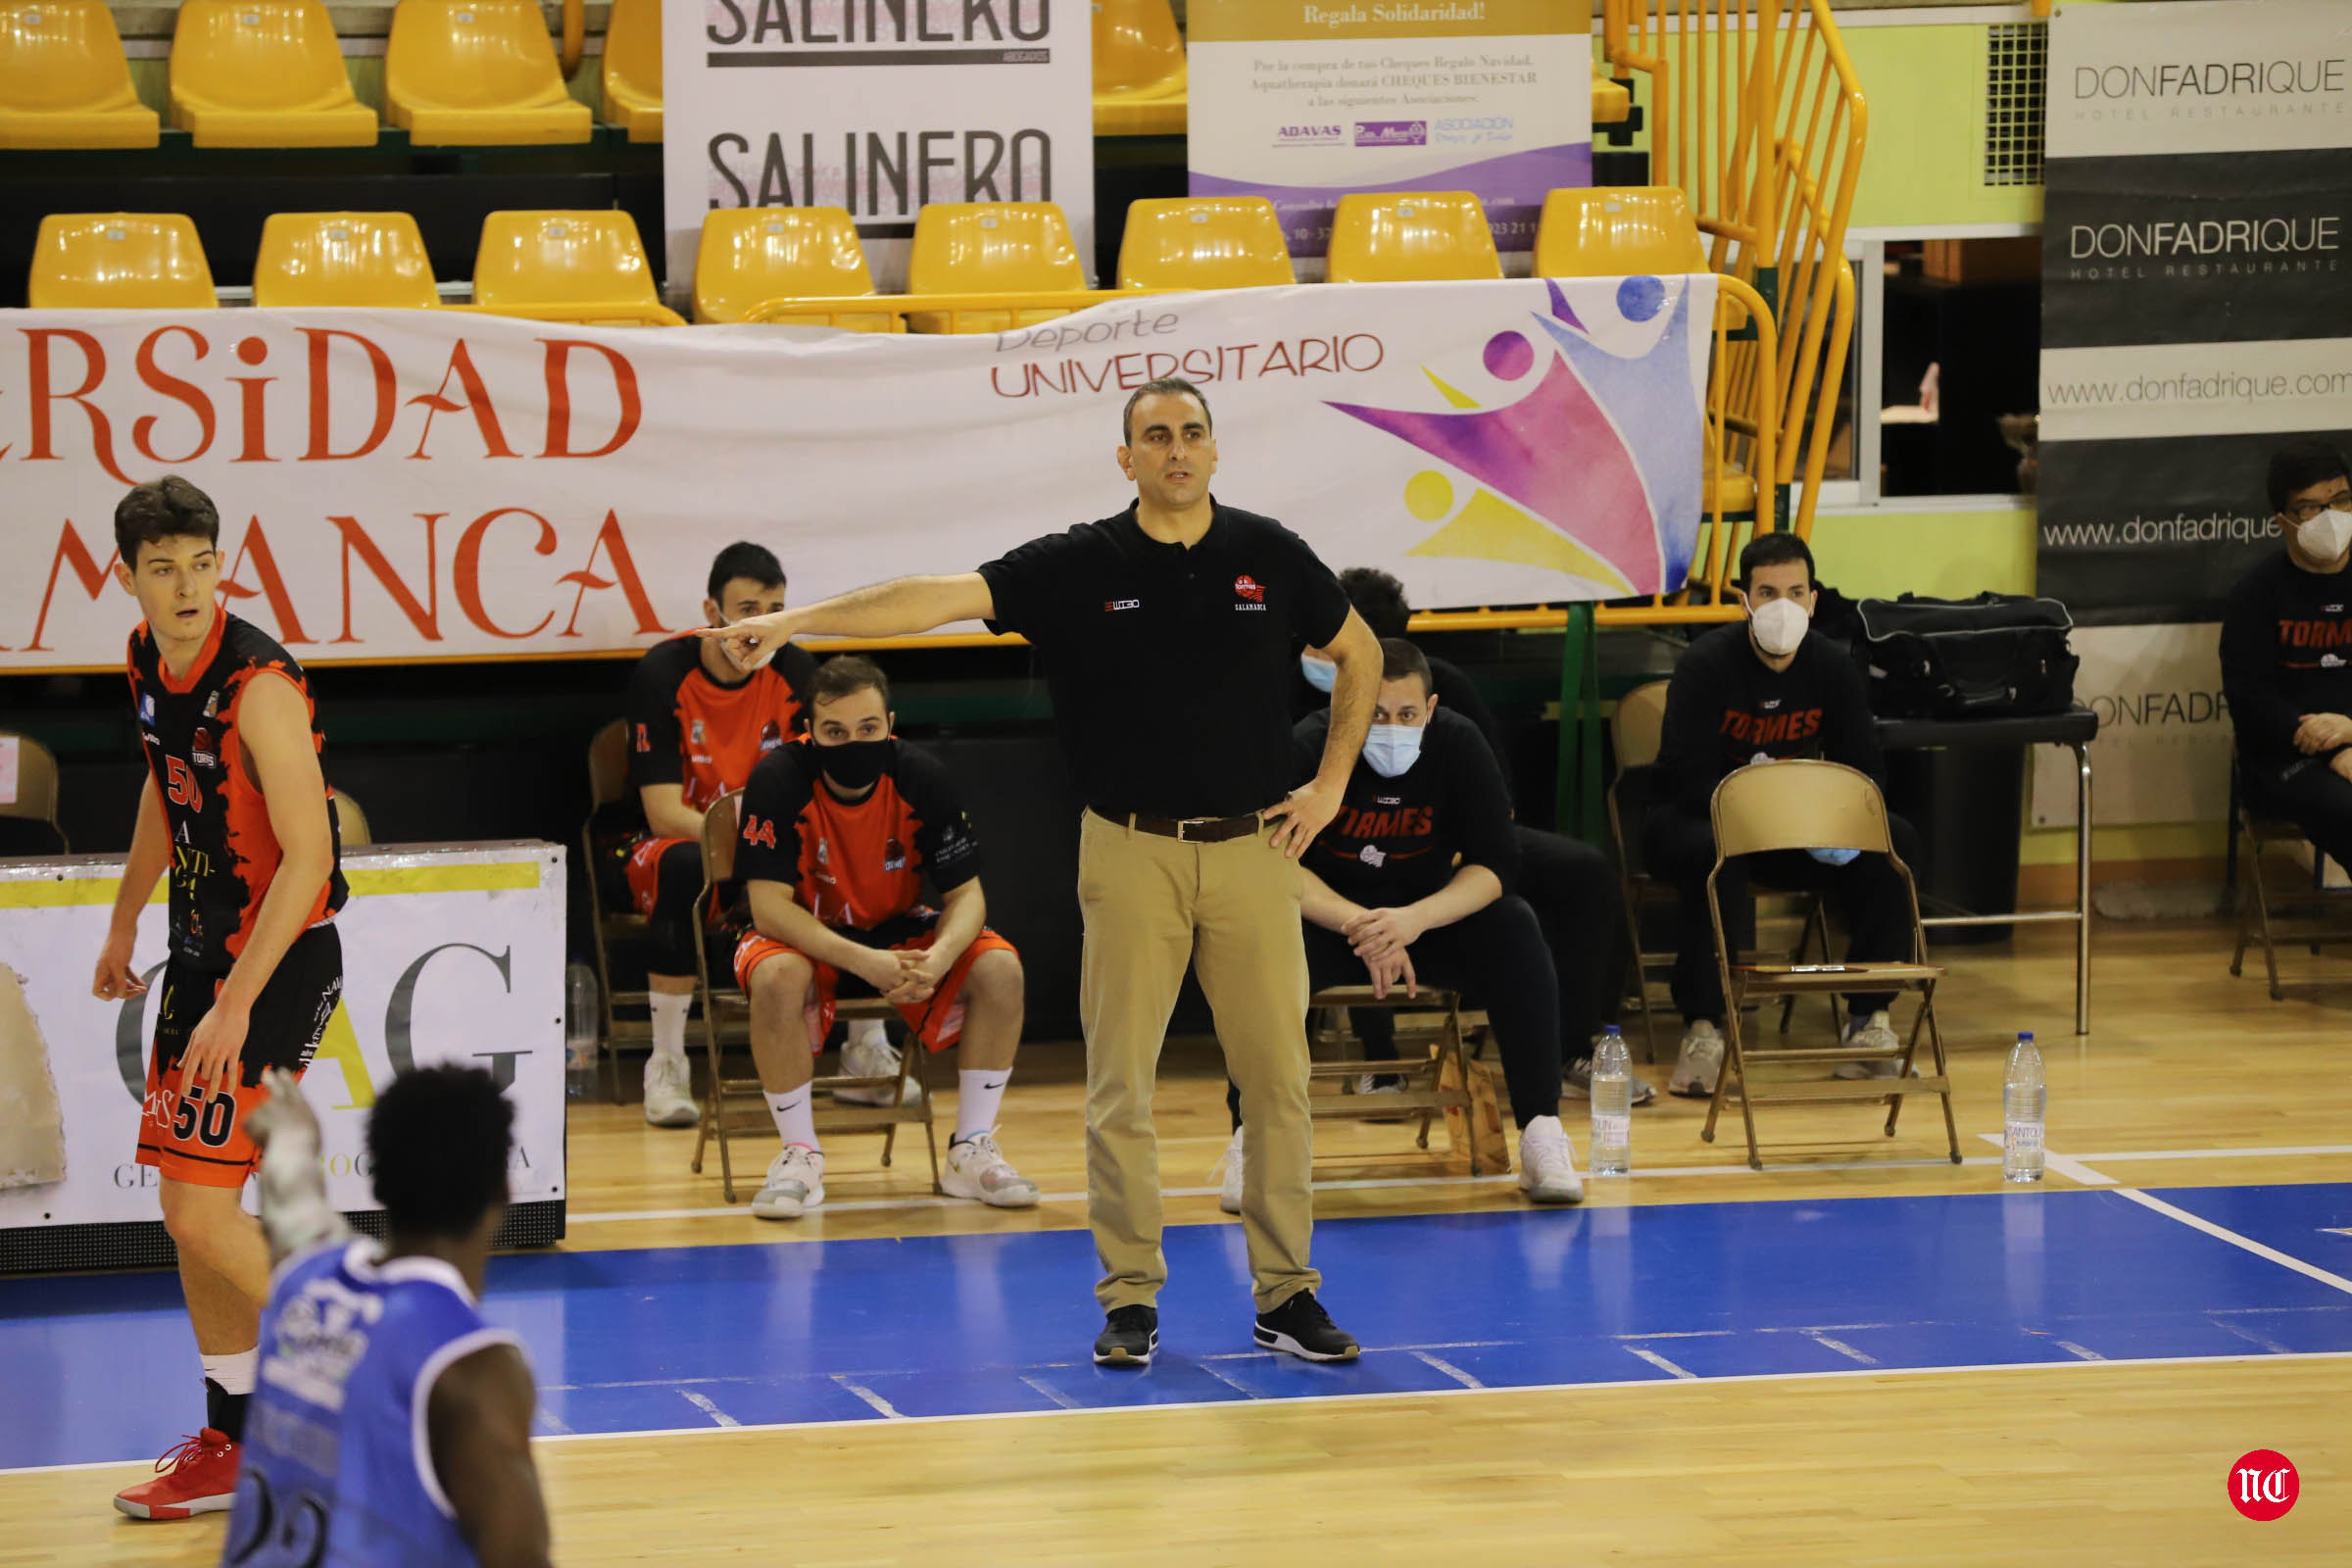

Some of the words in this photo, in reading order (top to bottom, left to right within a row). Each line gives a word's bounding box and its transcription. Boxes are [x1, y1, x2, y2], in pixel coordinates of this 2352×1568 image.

[1303, 5, 1367, 29] Regala
[1372, 2, 1486, 23] Solidaridad!
[1381, 74, 1449, 89] CHEQUES
[1454, 72, 1537, 86] BIENESTAR
[2075, 60, 2345, 99] DONFADRIQUE
[2074, 108, 2150, 121] HOTEL
[2172, 102, 2344, 118] RESTAURANTE
[1278, 125, 1342, 137] ADAVAS
[2071, 218, 2340, 259] DONFADRIQUE
[2071, 267, 2146, 279] HOTEL
[2165, 260, 2338, 276] RESTAURANTE
[995, 310, 1179, 352] Deporte
[991, 334, 1384, 398] UNIVERSITARIO
[2048, 369, 2352, 404] www.donfadrique.com
[1719, 708, 1823, 746] TORMES
[166, 754, 203, 813] 50
[743, 814, 776, 850] 44
[173, 1085, 235, 1148] 50
